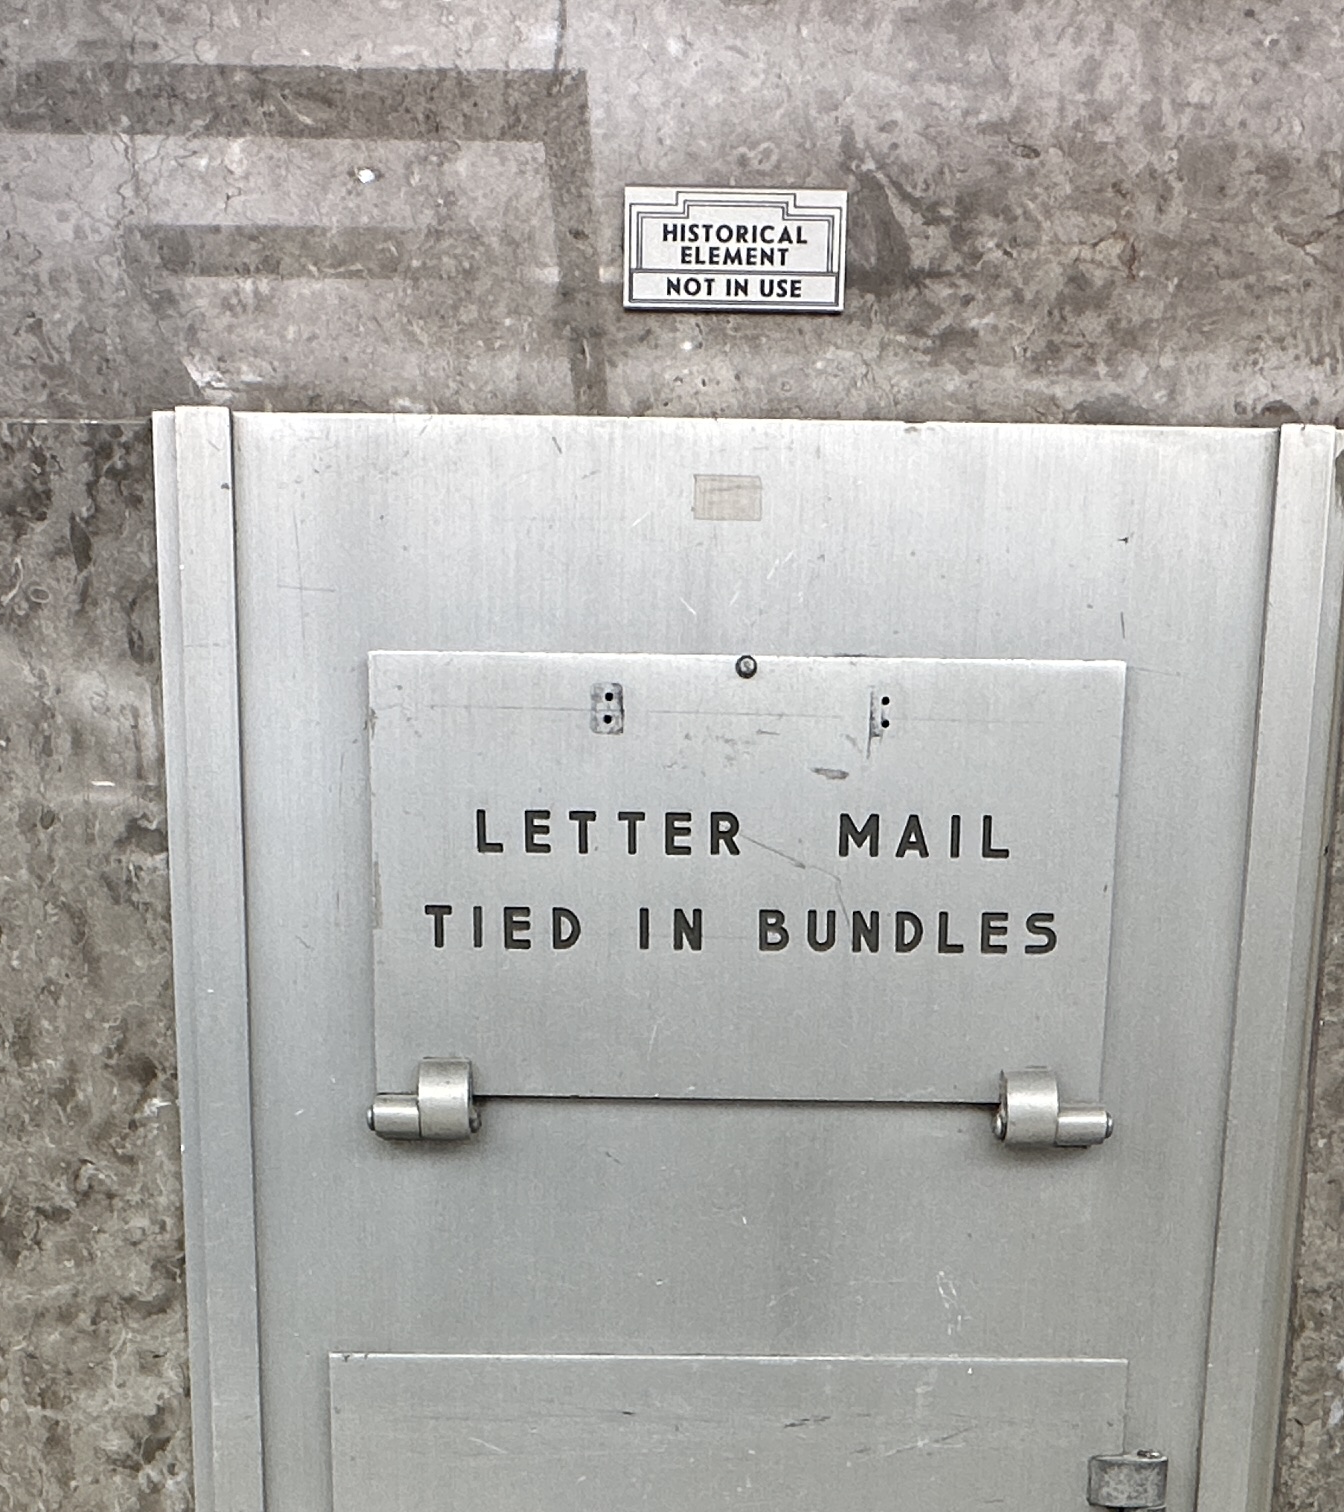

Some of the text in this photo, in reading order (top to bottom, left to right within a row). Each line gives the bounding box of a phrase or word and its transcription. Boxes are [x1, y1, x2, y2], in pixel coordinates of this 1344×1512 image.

[662, 222, 808, 244] HISTORICAL
[680, 246, 789, 266] ELEMENT
[666, 277, 803, 298] NOT IN USE
[475, 808, 1011, 860] LETTER MAIL
[424, 904, 1059, 956] TIED IN BUNDLES
